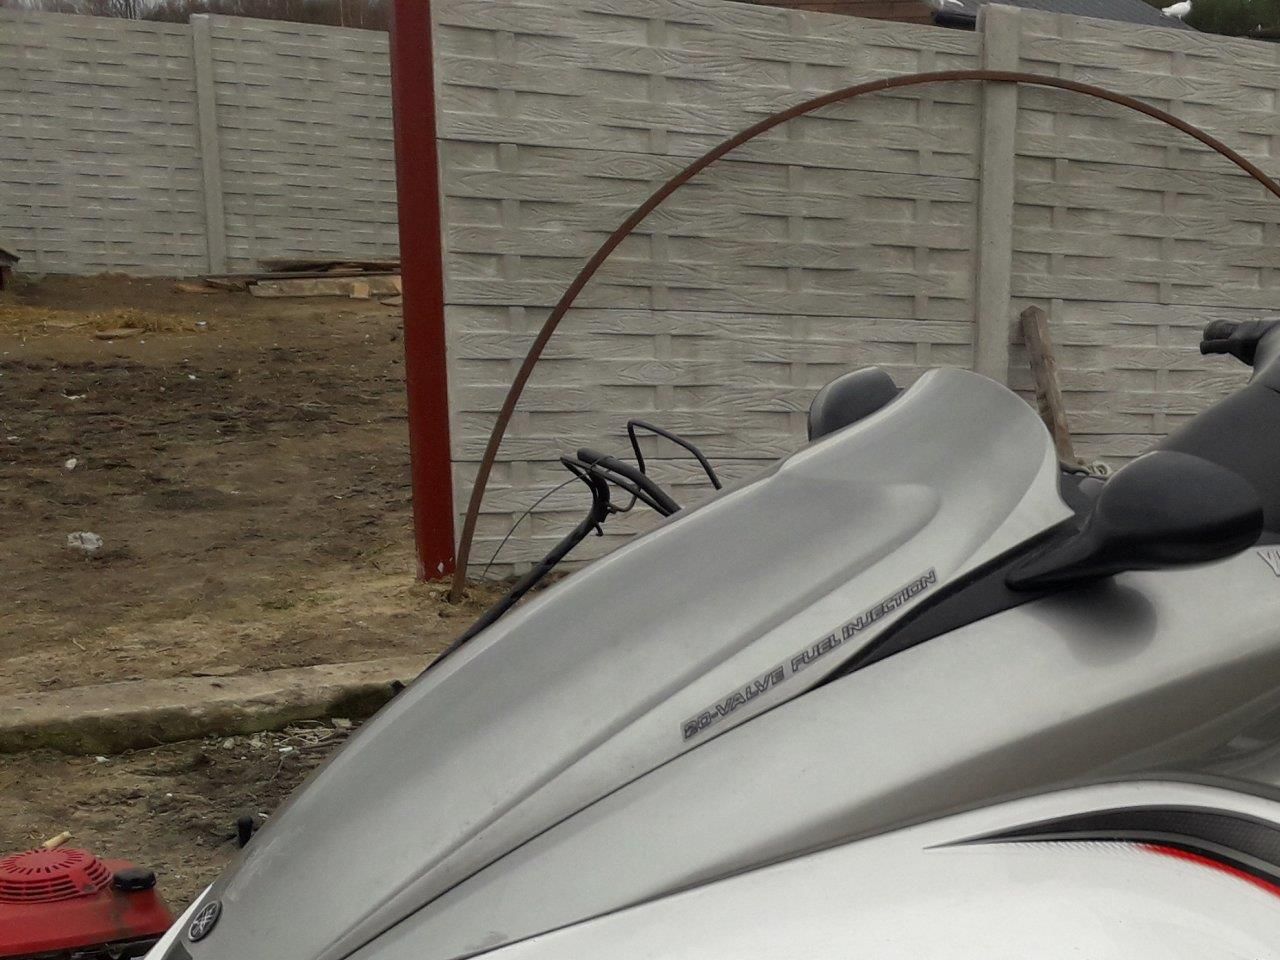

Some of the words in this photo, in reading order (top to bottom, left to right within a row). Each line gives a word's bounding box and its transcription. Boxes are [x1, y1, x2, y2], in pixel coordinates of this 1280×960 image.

[684, 665, 785, 740] 20-VALVE
[792, 631, 842, 673] FUEL
[843, 567, 937, 641] INJECTION
